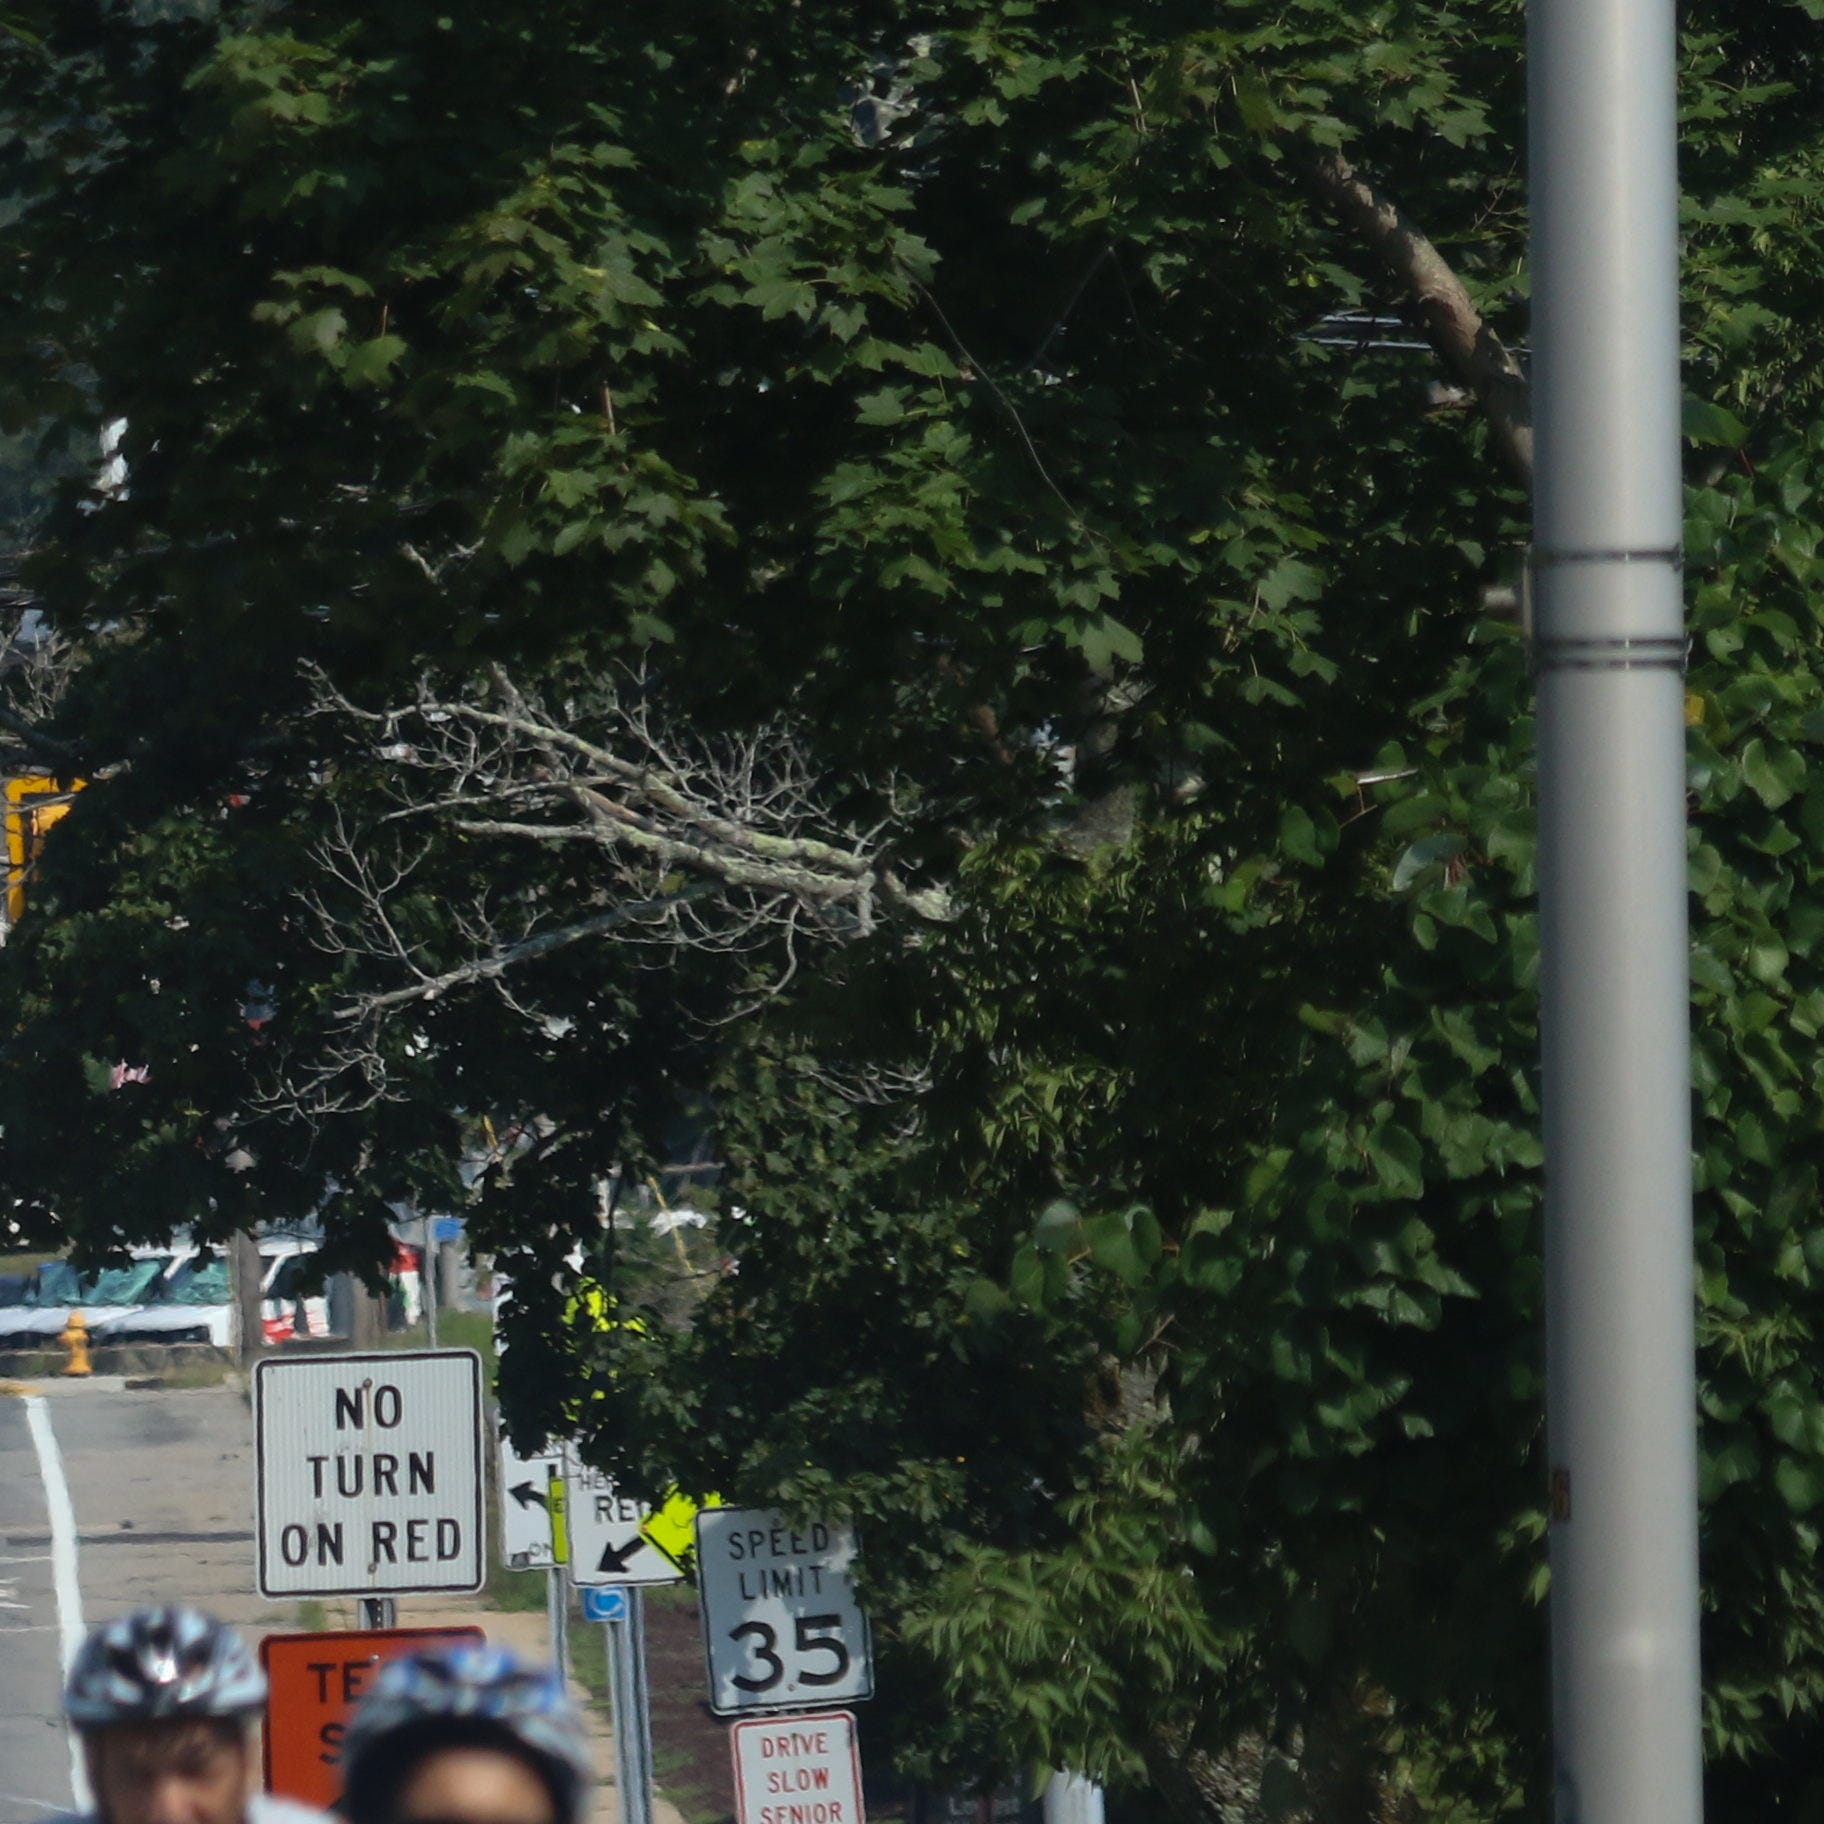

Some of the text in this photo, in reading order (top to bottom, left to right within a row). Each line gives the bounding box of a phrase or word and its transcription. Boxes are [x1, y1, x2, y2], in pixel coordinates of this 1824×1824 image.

[336, 1384, 402, 1430] NO
[306, 1451, 435, 1499] TURN
[281, 1518, 461, 1567] ON RED
[728, 1522, 830, 1560] SPEED
[739, 1565, 823, 1601] LIMIT
[728, 1613, 851, 1693] 35
[760, 1732, 829, 1759] DRIVE
[767, 1767, 829, 1794] SLOW
